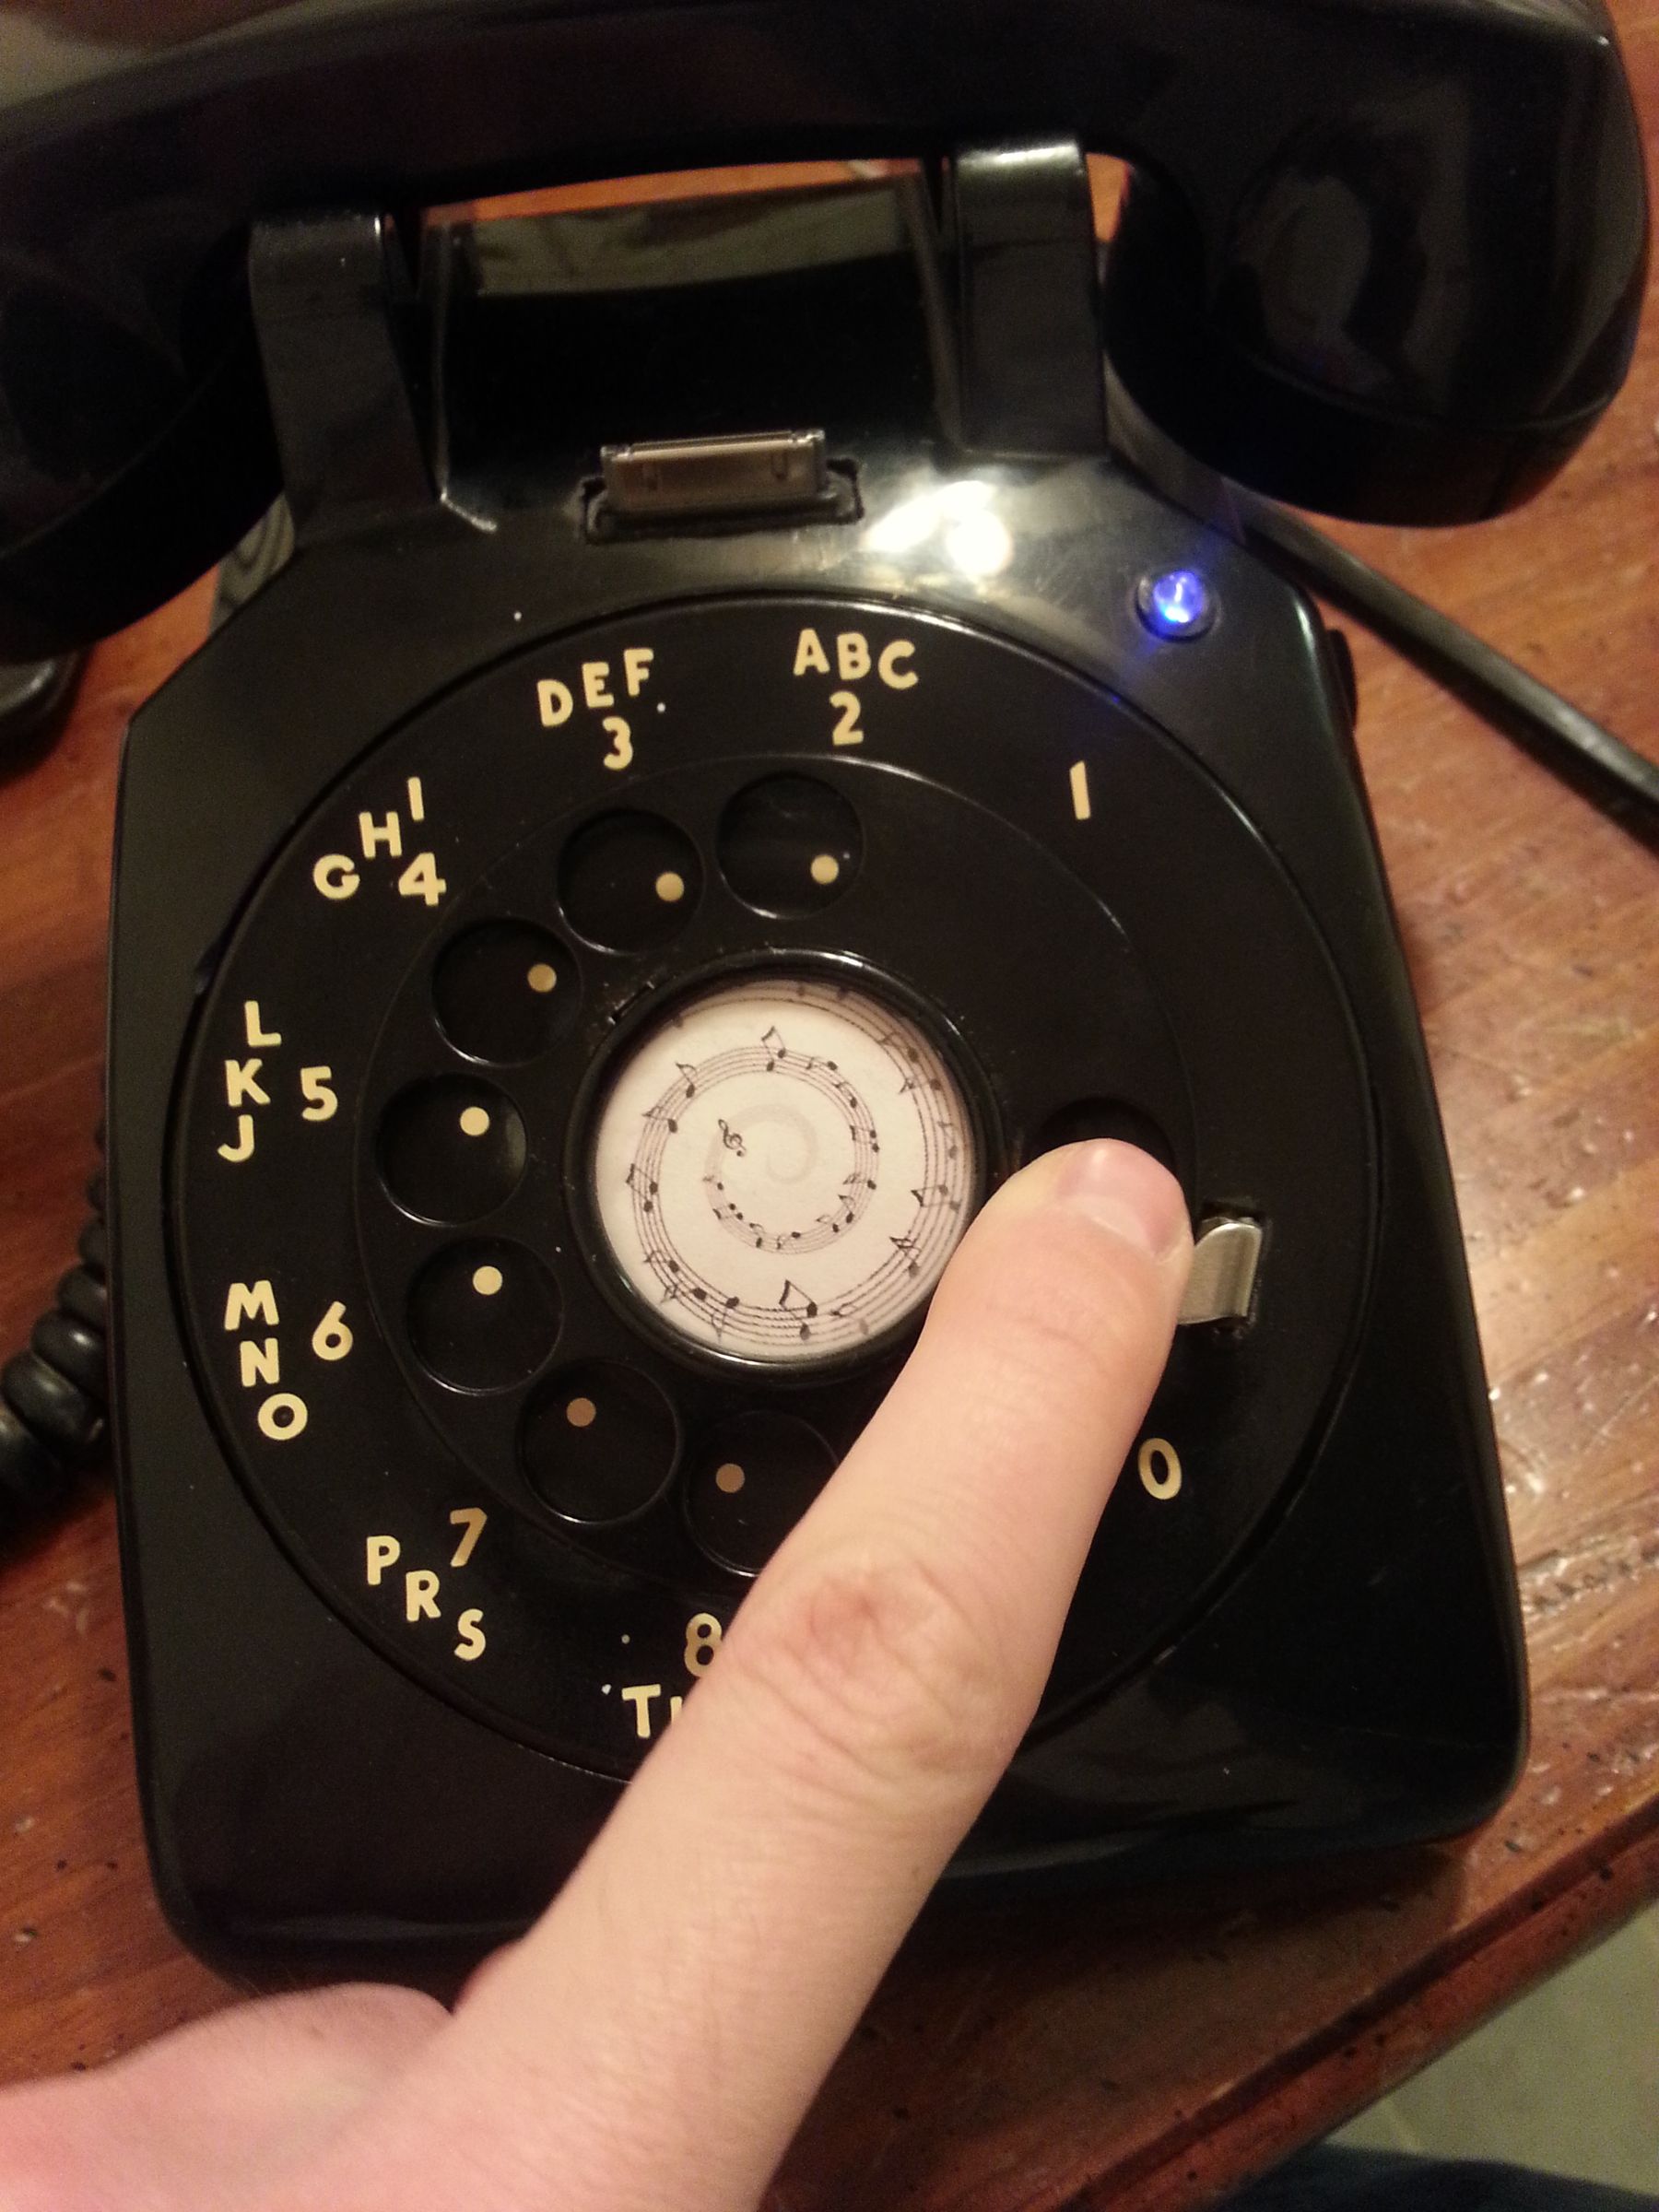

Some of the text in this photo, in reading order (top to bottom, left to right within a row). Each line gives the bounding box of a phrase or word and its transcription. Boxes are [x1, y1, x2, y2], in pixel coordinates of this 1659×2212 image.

[537, 648, 653, 726] DEF
[794, 629, 918, 689] ABC
[603, 717, 633, 770] 3
[830, 691, 864, 745] 2
[1069, 760, 1091, 820] 1
[398, 853, 446, 906] 4
[300, 1065, 338, 1122] 5
[312, 1300, 353, 1361] 6
[450, 1508, 488, 1567] 7
[685, 1613, 723, 1677] 8
